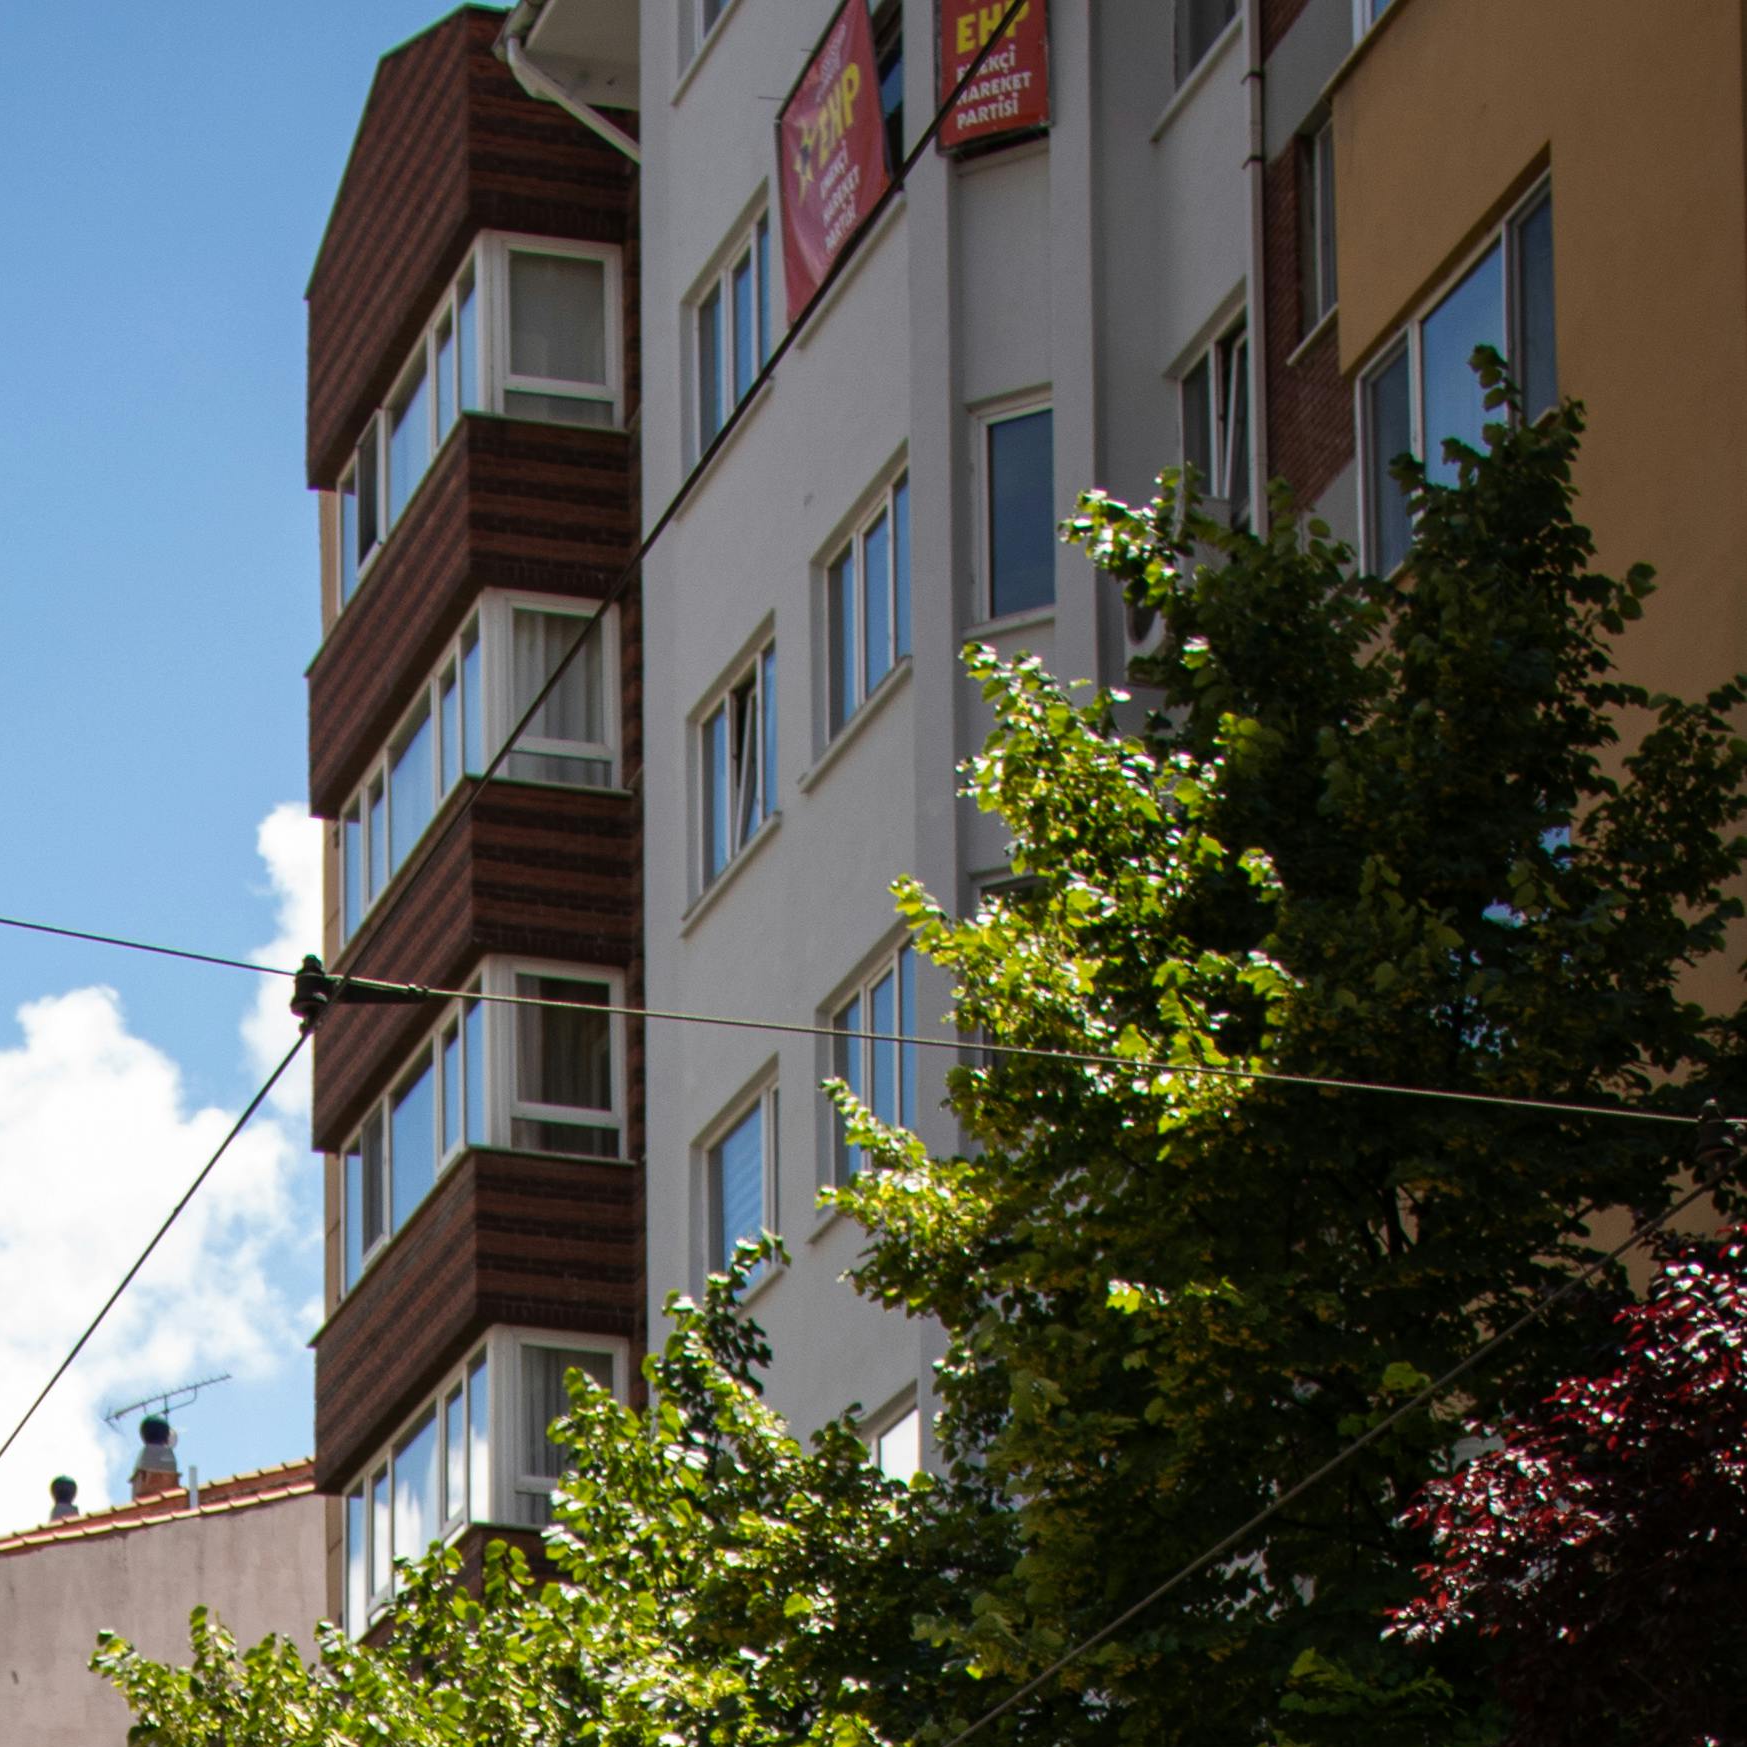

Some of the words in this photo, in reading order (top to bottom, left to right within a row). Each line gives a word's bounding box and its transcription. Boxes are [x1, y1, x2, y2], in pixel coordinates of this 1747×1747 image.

[957, 0, 1030, 54] EHP
[818, 62, 861, 170] EHP
[957, 91, 1019, 130] PARTİSİ
